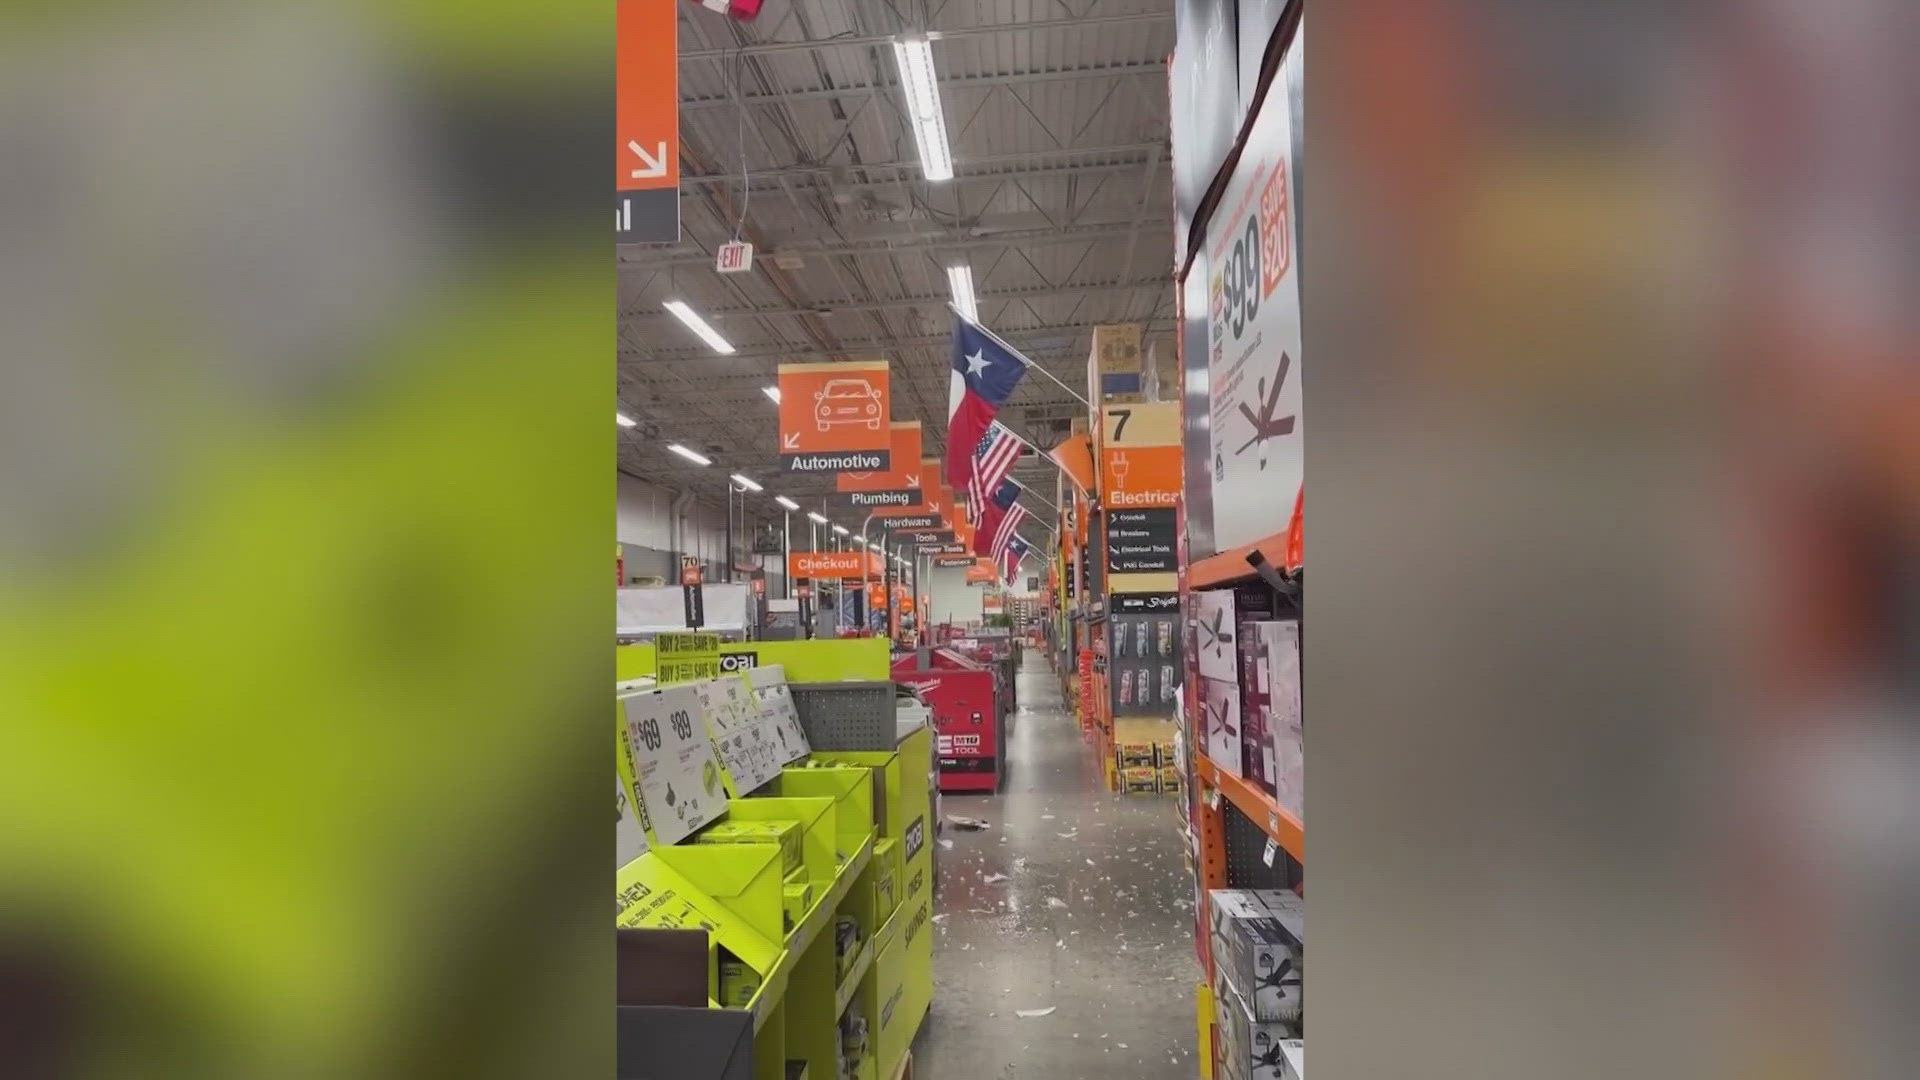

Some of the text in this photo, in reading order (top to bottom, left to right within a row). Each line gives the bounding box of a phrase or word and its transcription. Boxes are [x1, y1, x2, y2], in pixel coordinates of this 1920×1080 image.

[1262, 163, 1285, 232] SAVE
[722, 245, 745, 268] EXIT
[1264, 210, 1287, 283] $20
[1224, 214, 1259, 341] $99
[1108, 410, 1131, 441] 7
[791, 454, 880, 471] Automotive
[852, 492, 909, 506] Plumbing
[884, 517, 931, 527] Hardware
[915, 533, 937, 542] Tools
[683, 556, 698, 567] 70
[798, 557, 859, 570] Checkout
[660, 634, 673, 653] BUY
[675, 634, 679, 652] 2
[694, 634, 708, 651] SAVE
[660, 664, 674, 682] BUY
[675, 664, 680, 682] 3
[694, 662, 708, 680] SAVE
[638, 717, 662, 752] $69
[670, 709, 693, 741] $89
[905, 900, 927, 949] SAVINGS
